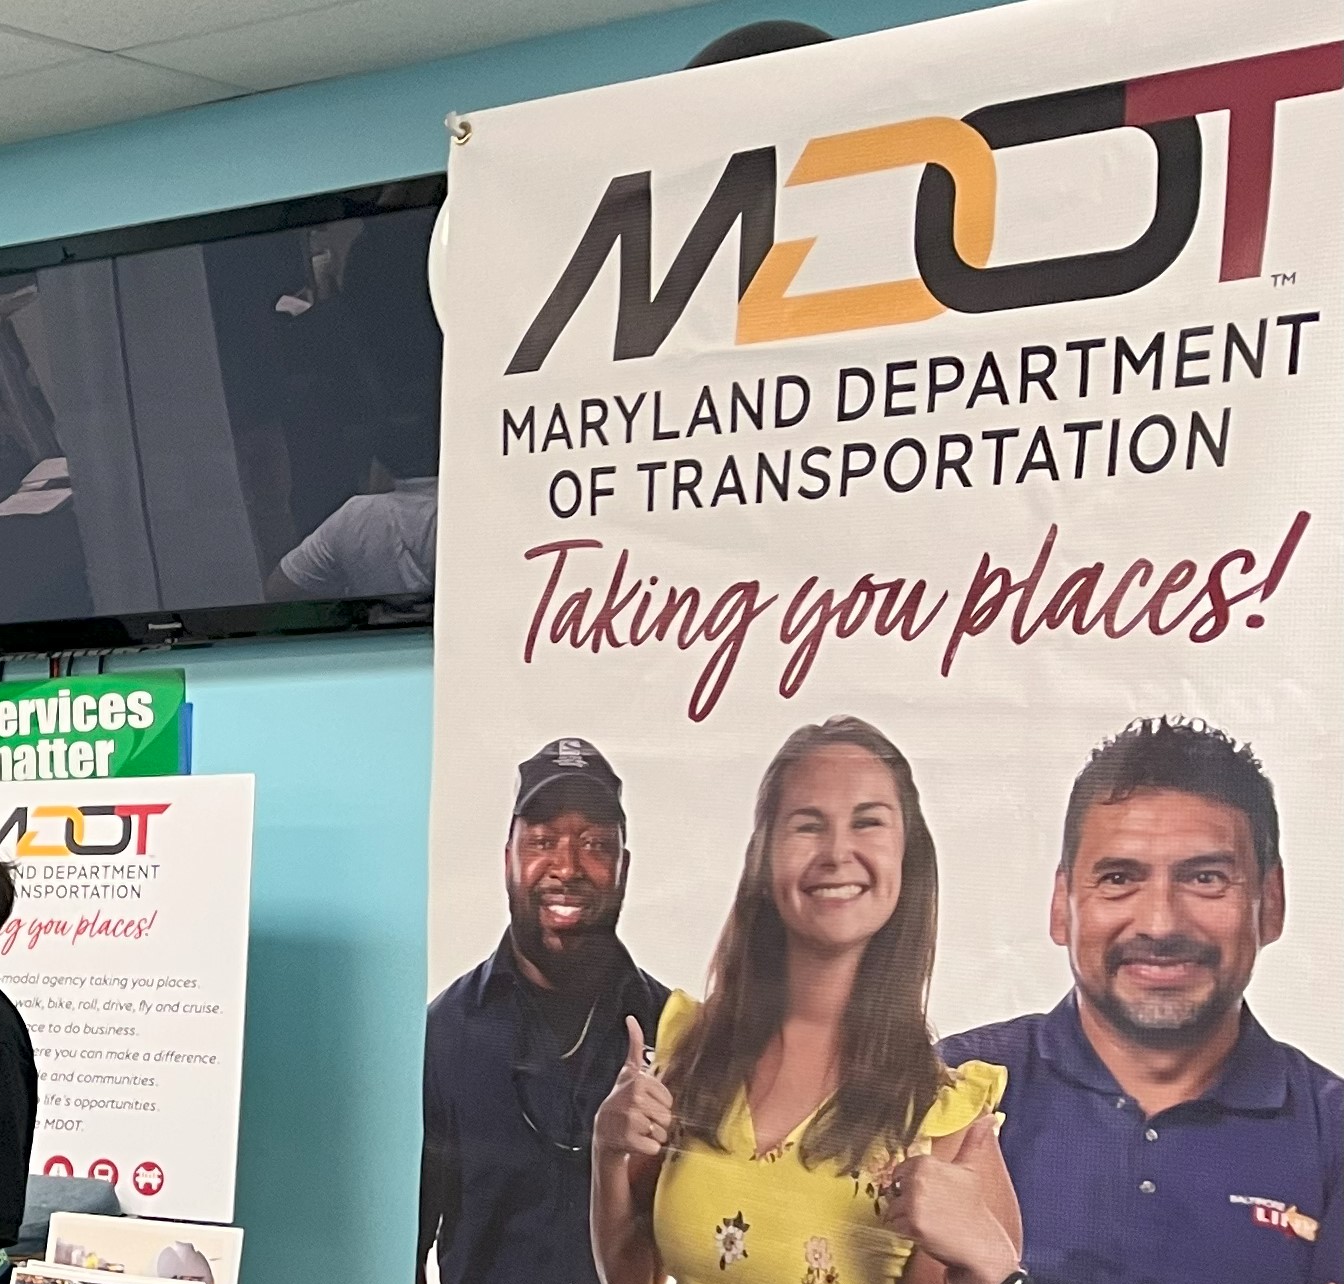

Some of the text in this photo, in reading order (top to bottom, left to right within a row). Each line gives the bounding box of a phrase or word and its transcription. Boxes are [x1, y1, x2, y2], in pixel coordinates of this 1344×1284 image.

[504, 39, 1344, 375] MDOT
[501, 310, 1320, 456] MARYLAND DEPARTMENT
[548, 407, 1231, 519] OF TRANSPORTATION
[523, 510, 1312, 723] Taking you places!
[43, 865, 160, 880] DEPARTMENT
[13, 884, 141, 899] NSPORTATION
[27, 918, 73, 949] you
[71, 909, 158, 946] places!
[42, 975, 87, 988] agency
[89, 974, 128, 990] taking
[131, 977, 154, 990] you
[156, 976, 200, 991] places.
[15, 997, 224, 1015] walk, bike, roll, drive, fly and cruise.
[48, 1022, 61, 1033] to
[64, 1022, 80, 1034] do
[83, 1023, 140, 1036] business.
[33, 1048, 220, 1065] ere you can make a difference.
[50, 1071, 74, 1082] and
[77, 1073, 159, 1087] communities.
[44, 1094, 71, 1106] life's
[74, 1098, 160, 1112] opportunities.
